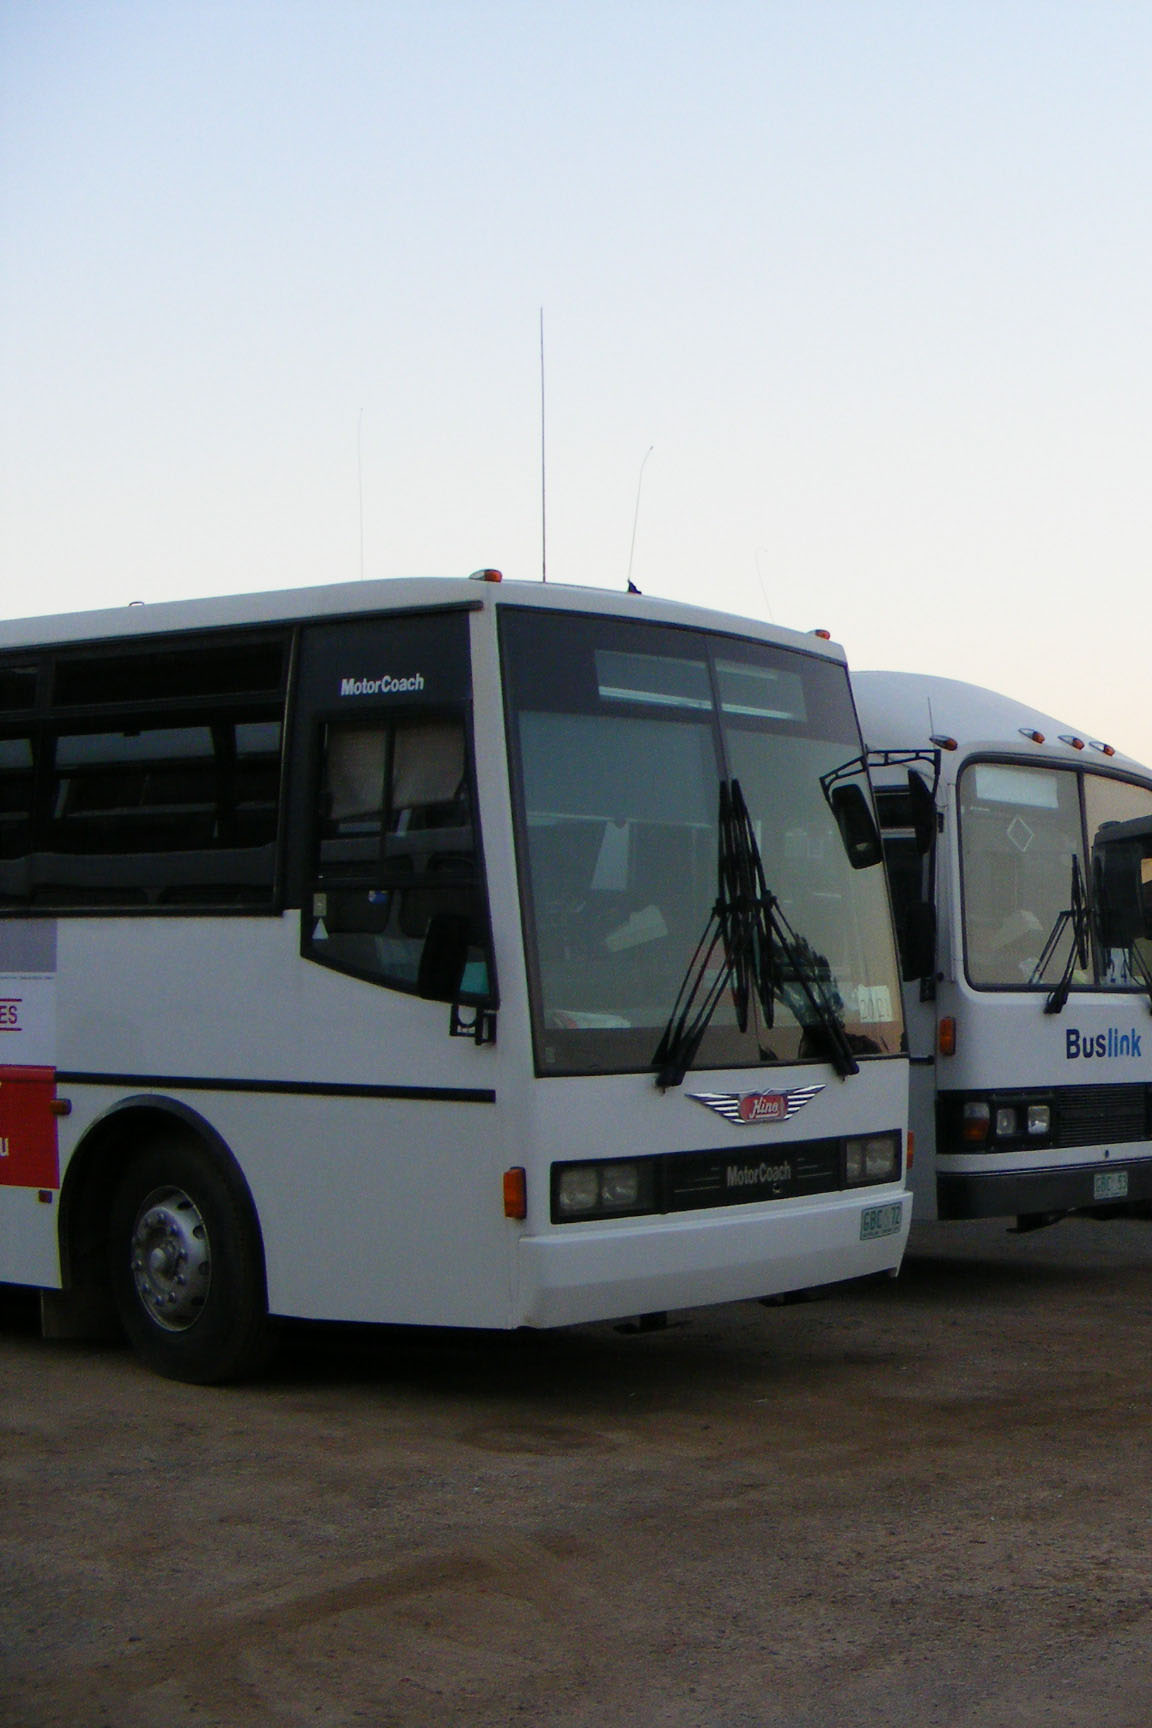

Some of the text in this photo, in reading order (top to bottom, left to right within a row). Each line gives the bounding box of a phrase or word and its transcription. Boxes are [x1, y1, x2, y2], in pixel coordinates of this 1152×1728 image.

[340, 673, 425, 696] MotorCoach
[1065, 1027, 1142, 1060] Buslink
[726, 1160, 793, 1187] MotorCoach
